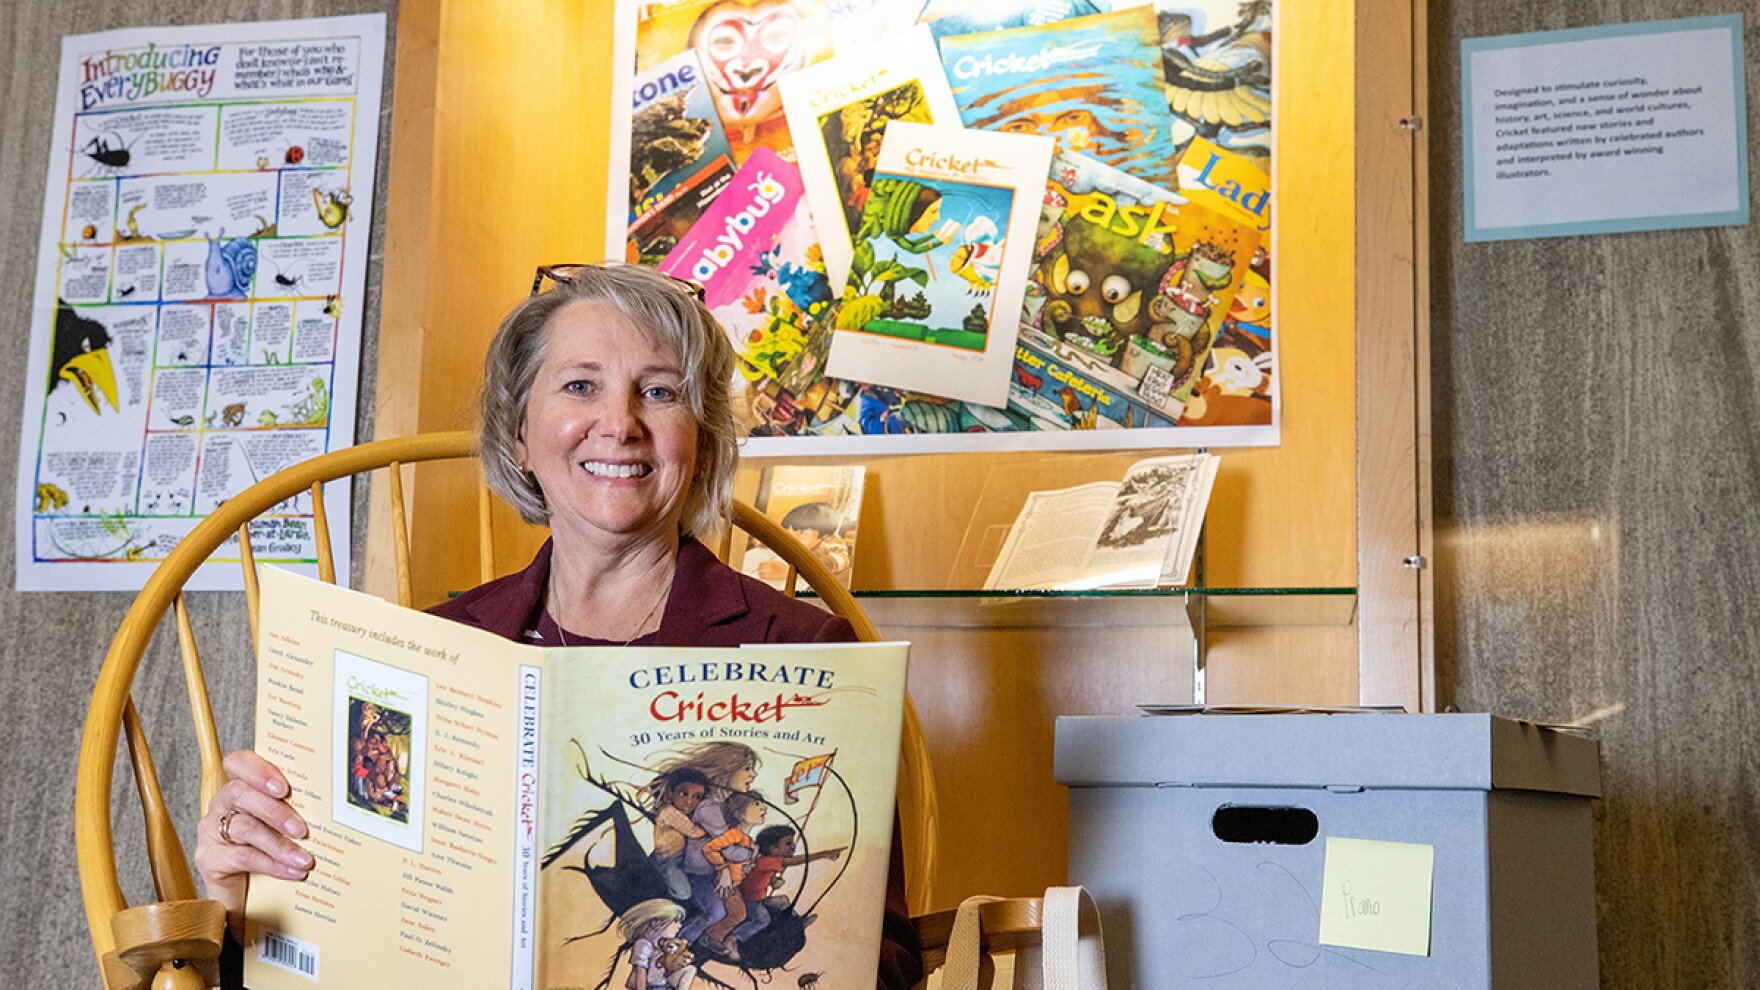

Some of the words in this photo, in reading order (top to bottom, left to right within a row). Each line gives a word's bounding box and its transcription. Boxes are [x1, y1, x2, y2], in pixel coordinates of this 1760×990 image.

[953, 45, 1075, 79] Cricket
[1494, 86, 1540, 98] Designed
[1542, 84, 1553, 94] to
[1555, 81, 1600, 92] stimulate
[1602, 77, 1648, 88] curiosity,
[1494, 99, 1556, 112] imagination,
[1558, 96, 1577, 105] and
[1588, 94, 1616, 103] sense
[1618, 91, 1629, 100] of
[1631, 89, 1670, 99] wonder
[1673, 86, 1703, 96] about
[1495, 113, 1531, 125] history,
[1534, 112, 1551, 122] art,
[1553, 109, 1592, 119] science,
[1594, 107, 1614, 116] and
[1616, 104, 1645, 114] world
[1647, 101, 1691, 112] cultures,
[1495, 128, 1529, 138] Cricket
[1531, 124, 1573, 135] featured
[1576, 123, 1597, 132] new
[1599, 119, 1632, 129] stories
[1635, 118, 1655, 127] and
[1495, 139, 1553, 152] adaptations
[1556, 136, 1592, 146] written
[1594, 135, 1607, 145] by
[1609, 131, 1663, 143] celebrated
[1665, 128, 1705, 139] authors
[905, 147, 990, 173] Cricket
[1496, 156, 1515, 166] and
[1517, 152, 1573, 165] interpreted
[1575, 151, 1587, 161] by
[1590, 148, 1621, 158] award
[1624, 145, 1664, 157] winning
[1496, 168, 1552, 180] illustrators.
[692, 172, 785, 285] abybug
[1081, 191, 1177, 254] ask
[310, 610, 328, 625] This
[330, 617, 367, 639] treasury
[369, 627, 405, 649] includes
[407, 639, 421, 653] the
[424, 646, 447, 661] work
[448, 653, 461, 666] of
[347, 675, 392, 699] Cricket
[629, 662, 835, 690] CELEBRATE
[650, 690, 812, 724] Cricket
[522, 673, 536, 768] CELEBRATE
[629, 732, 651, 748] 30
[656, 729, 696, 742] Years
[700, 726, 715, 738] of
[720, 727, 769, 739] Stories
[773, 728, 801, 742] and
[802, 734, 826, 746] Art
[520, 772, 536, 828] Cricket
[522, 847, 531, 859] 30
[522, 861, 530, 880] Years
[521, 882, 529, 890] of
[521, 892, 529, 918] Stories
[521, 920, 529, 934] and
